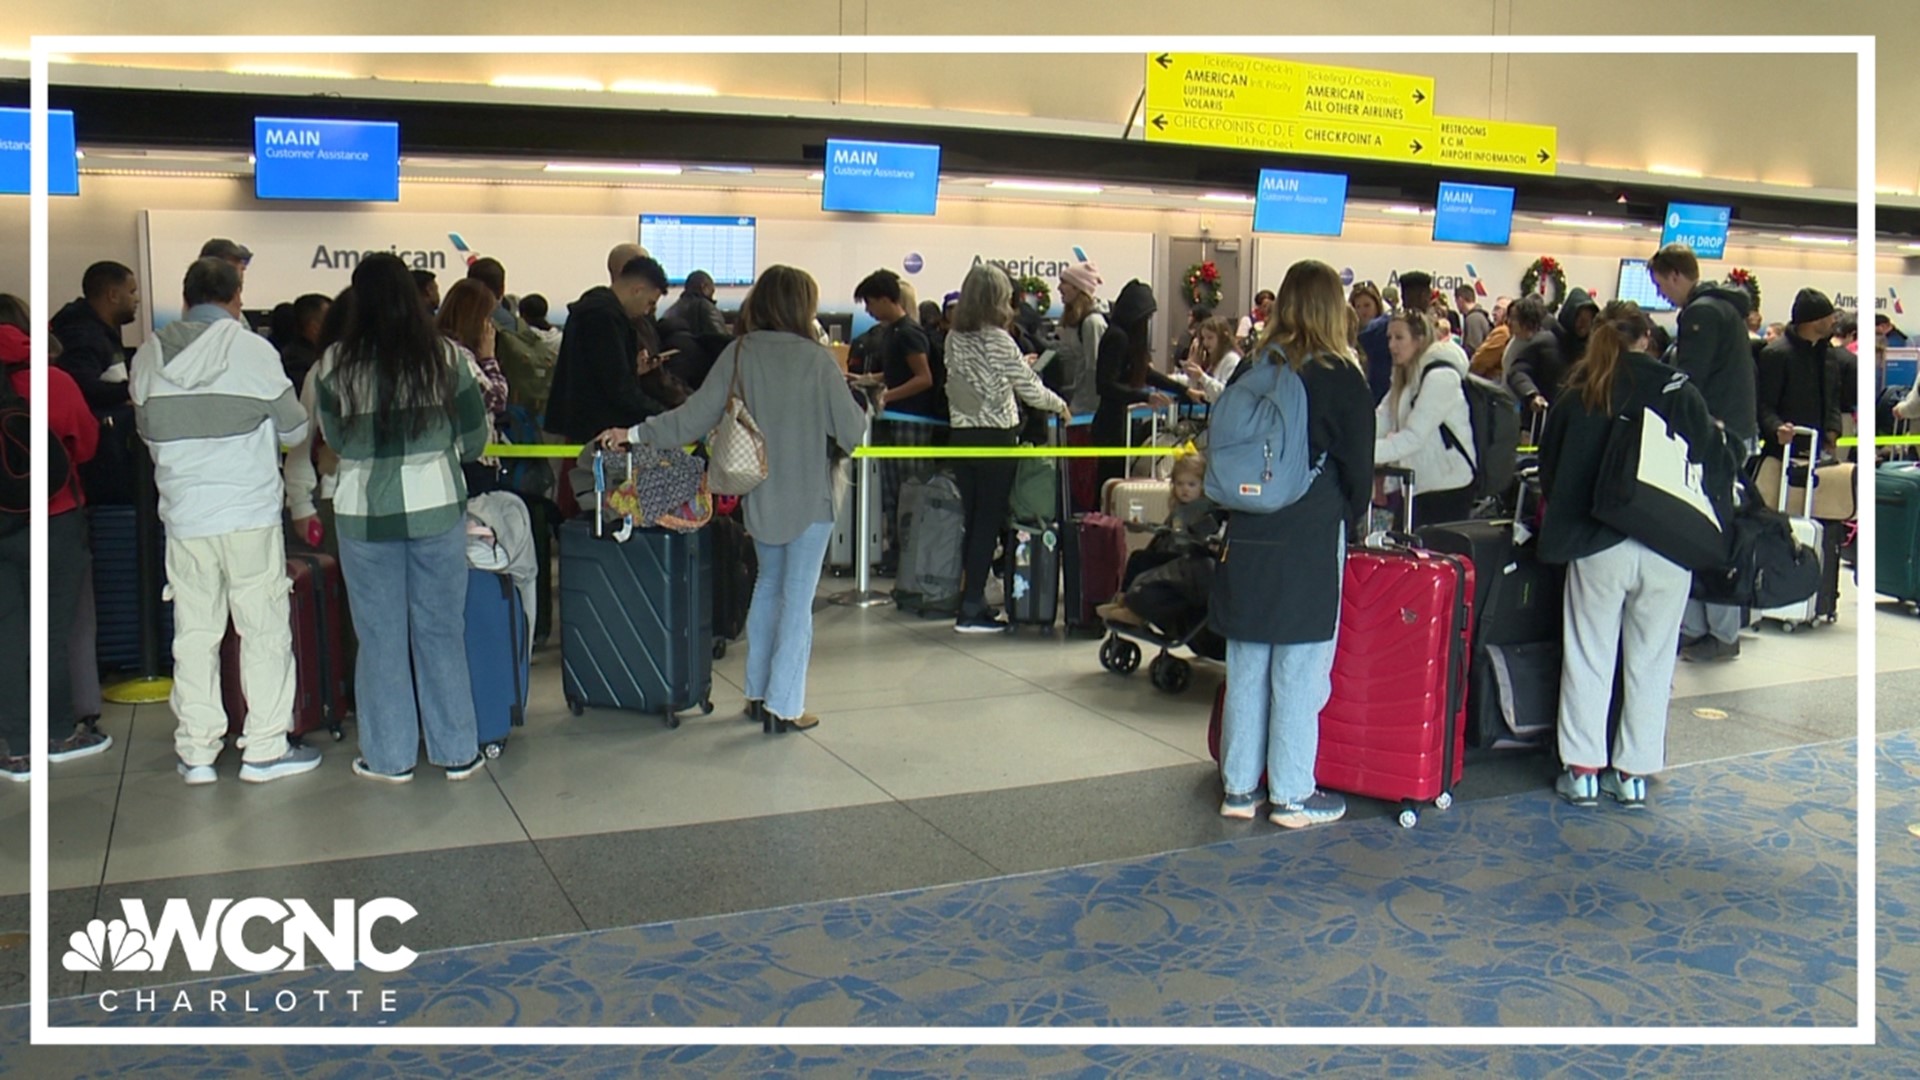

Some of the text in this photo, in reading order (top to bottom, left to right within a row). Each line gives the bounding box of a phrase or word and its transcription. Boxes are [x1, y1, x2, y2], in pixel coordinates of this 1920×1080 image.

[1204, 55, 1244, 71] Ticketing
[1185, 69, 1248, 87] AMERICAN
[1307, 71, 1347, 86] Ticketing
[1183, 86, 1236, 99] LUFTHANSA
[1306, 85, 1365, 101] AMERICAN
[1183, 97, 1223, 111] VOLARIS
[1305, 100, 1404, 120] ALL OTHER AIRLINES
[1173, 115, 1255, 134] CHECKPOINTS
[1288, 125, 1295, 137] E
[1441, 123, 1487, 137] RESTROOMS
[265, 129, 320, 146] MAIN
[1305, 129, 1382, 147] CHECKPOINT A
[1456, 138, 1464, 147] M
[265, 147, 369, 161] Customer Assistance
[834, 149, 878, 166] MAIN
[1441, 149, 1527, 164] AIRPORT INFORMATION
[833, 165, 915, 179] Customer Assistance
[1263, 176, 1299, 192] MAIN
[1443, 190, 1474, 205] MAIN
[1696, 235, 1723, 248] DROP
[311, 244, 446, 269] Amcan
[1388, 270, 1464, 291] Aican
[1834, 292, 1887, 309] Amean
